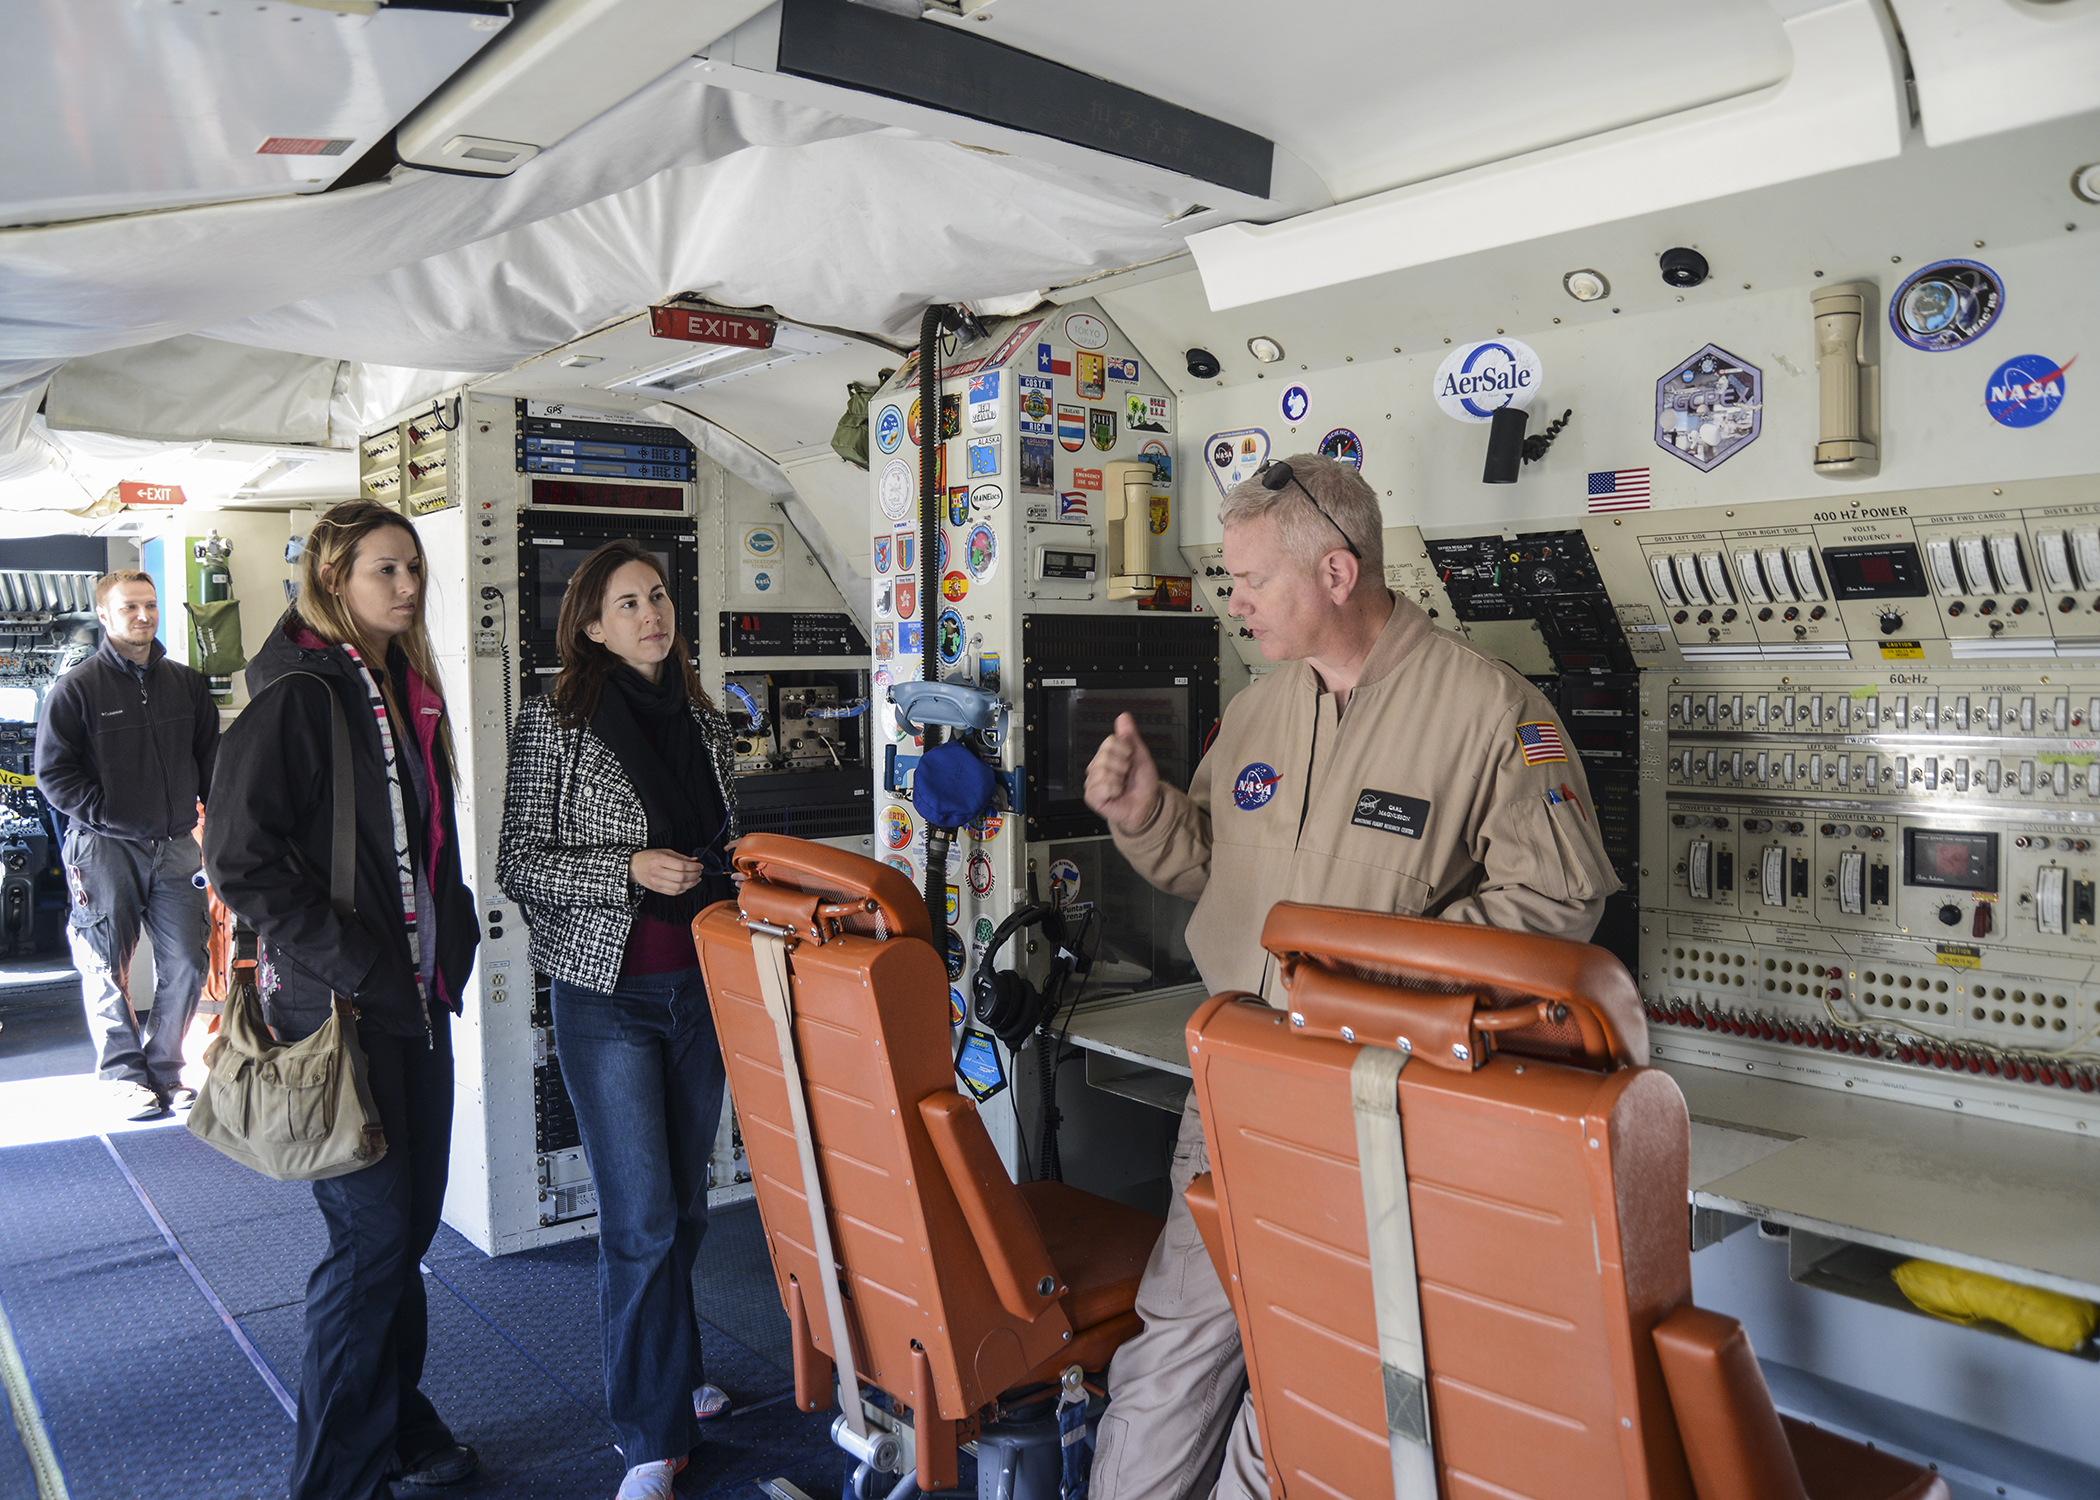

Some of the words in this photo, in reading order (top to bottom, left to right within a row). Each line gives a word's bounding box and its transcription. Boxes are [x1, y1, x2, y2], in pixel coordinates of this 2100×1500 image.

[688, 316, 743, 339] EXIT
[1074, 326, 1101, 338] TOKYO
[1025, 378, 1047, 389] COSTA
[1441, 363, 1531, 397] AerSale
[1991, 380, 2062, 402] NASA
[546, 405, 563, 415] GPS
[977, 402, 991, 413] NEW
[972, 411, 997, 424] ZEALAND
[1029, 421, 1046, 432] RICA
[1327, 430, 1351, 440] SCIENCE
[977, 436, 1000, 446] ALASKA
[1215, 451, 1234, 461] NASA
[147, 487, 172, 501] EXIT
[1813, 511, 1837, 522] 400
[1840, 509, 1859, 520] HZ
[1861, 506, 1909, 519] POWER
[2043, 507, 2070, 516] DISTR
[2073, 505, 2090, 514] AFT
[1930, 516, 1954, 524] DISTR
[1978, 512, 2006, 520] CARGO
[1851, 525, 1877, 533] VOLTS
[1843, 533, 1891, 543] FREQUENCY
[1889, 673, 1905, 684] 60
[1912, 673, 1928, 684] Hz
[1981, 685, 1995, 693] AFT
[1997, 685, 2022, 693] CARGO
[2069, 740, 2097, 749] INOP
[1237, 780, 1271, 796] NASA
[1679, 804, 1712, 812] CONVERTER
[1750, 808, 1785, 817] CONVERTER
[884, 811, 905, 821] PERTH
[1828, 813, 1864, 821] CONVERTER
[966, 848, 993, 864] SOUTHERN
[1062, 905, 1083, 913] Punta
[1944, 946, 1972, 955] CAUTION
